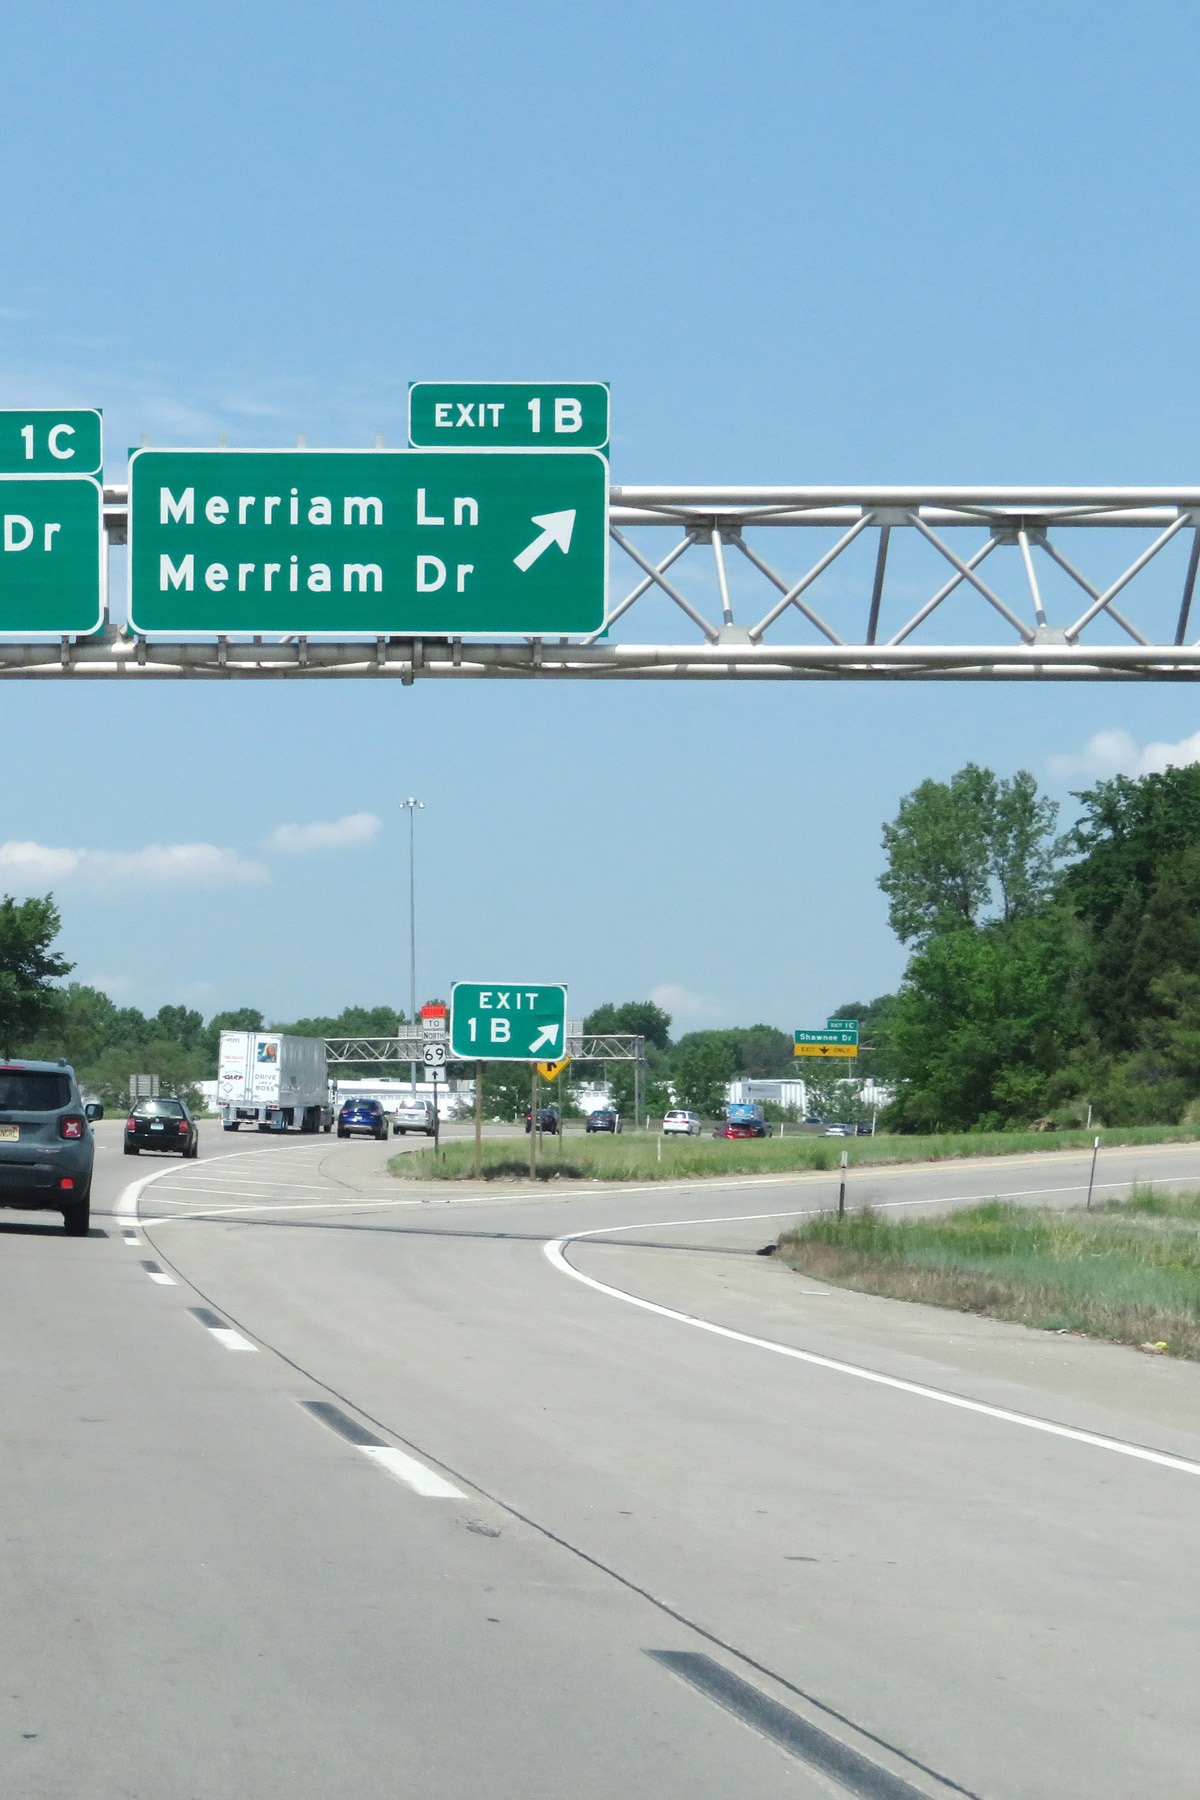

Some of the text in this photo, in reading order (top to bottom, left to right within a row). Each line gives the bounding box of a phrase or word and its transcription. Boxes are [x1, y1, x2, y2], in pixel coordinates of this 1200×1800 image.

[436, 397, 583, 433] EXIT 1B
[20, 423, 76, 460] 1C
[159, 486, 479, 526] Merriam Ln
[3, 514, 62, 552] Dr
[159, 553, 475, 593] Merriam Dr
[479, 991, 539, 1010] EXIT
[423, 1030, 445, 1039] NORTH
[429, 1020, 440, 1028] TO
[467, 1017, 511, 1043] 1B
[800, 1033, 838, 1041] Shawnee
[425, 1048, 444, 1061] 69
